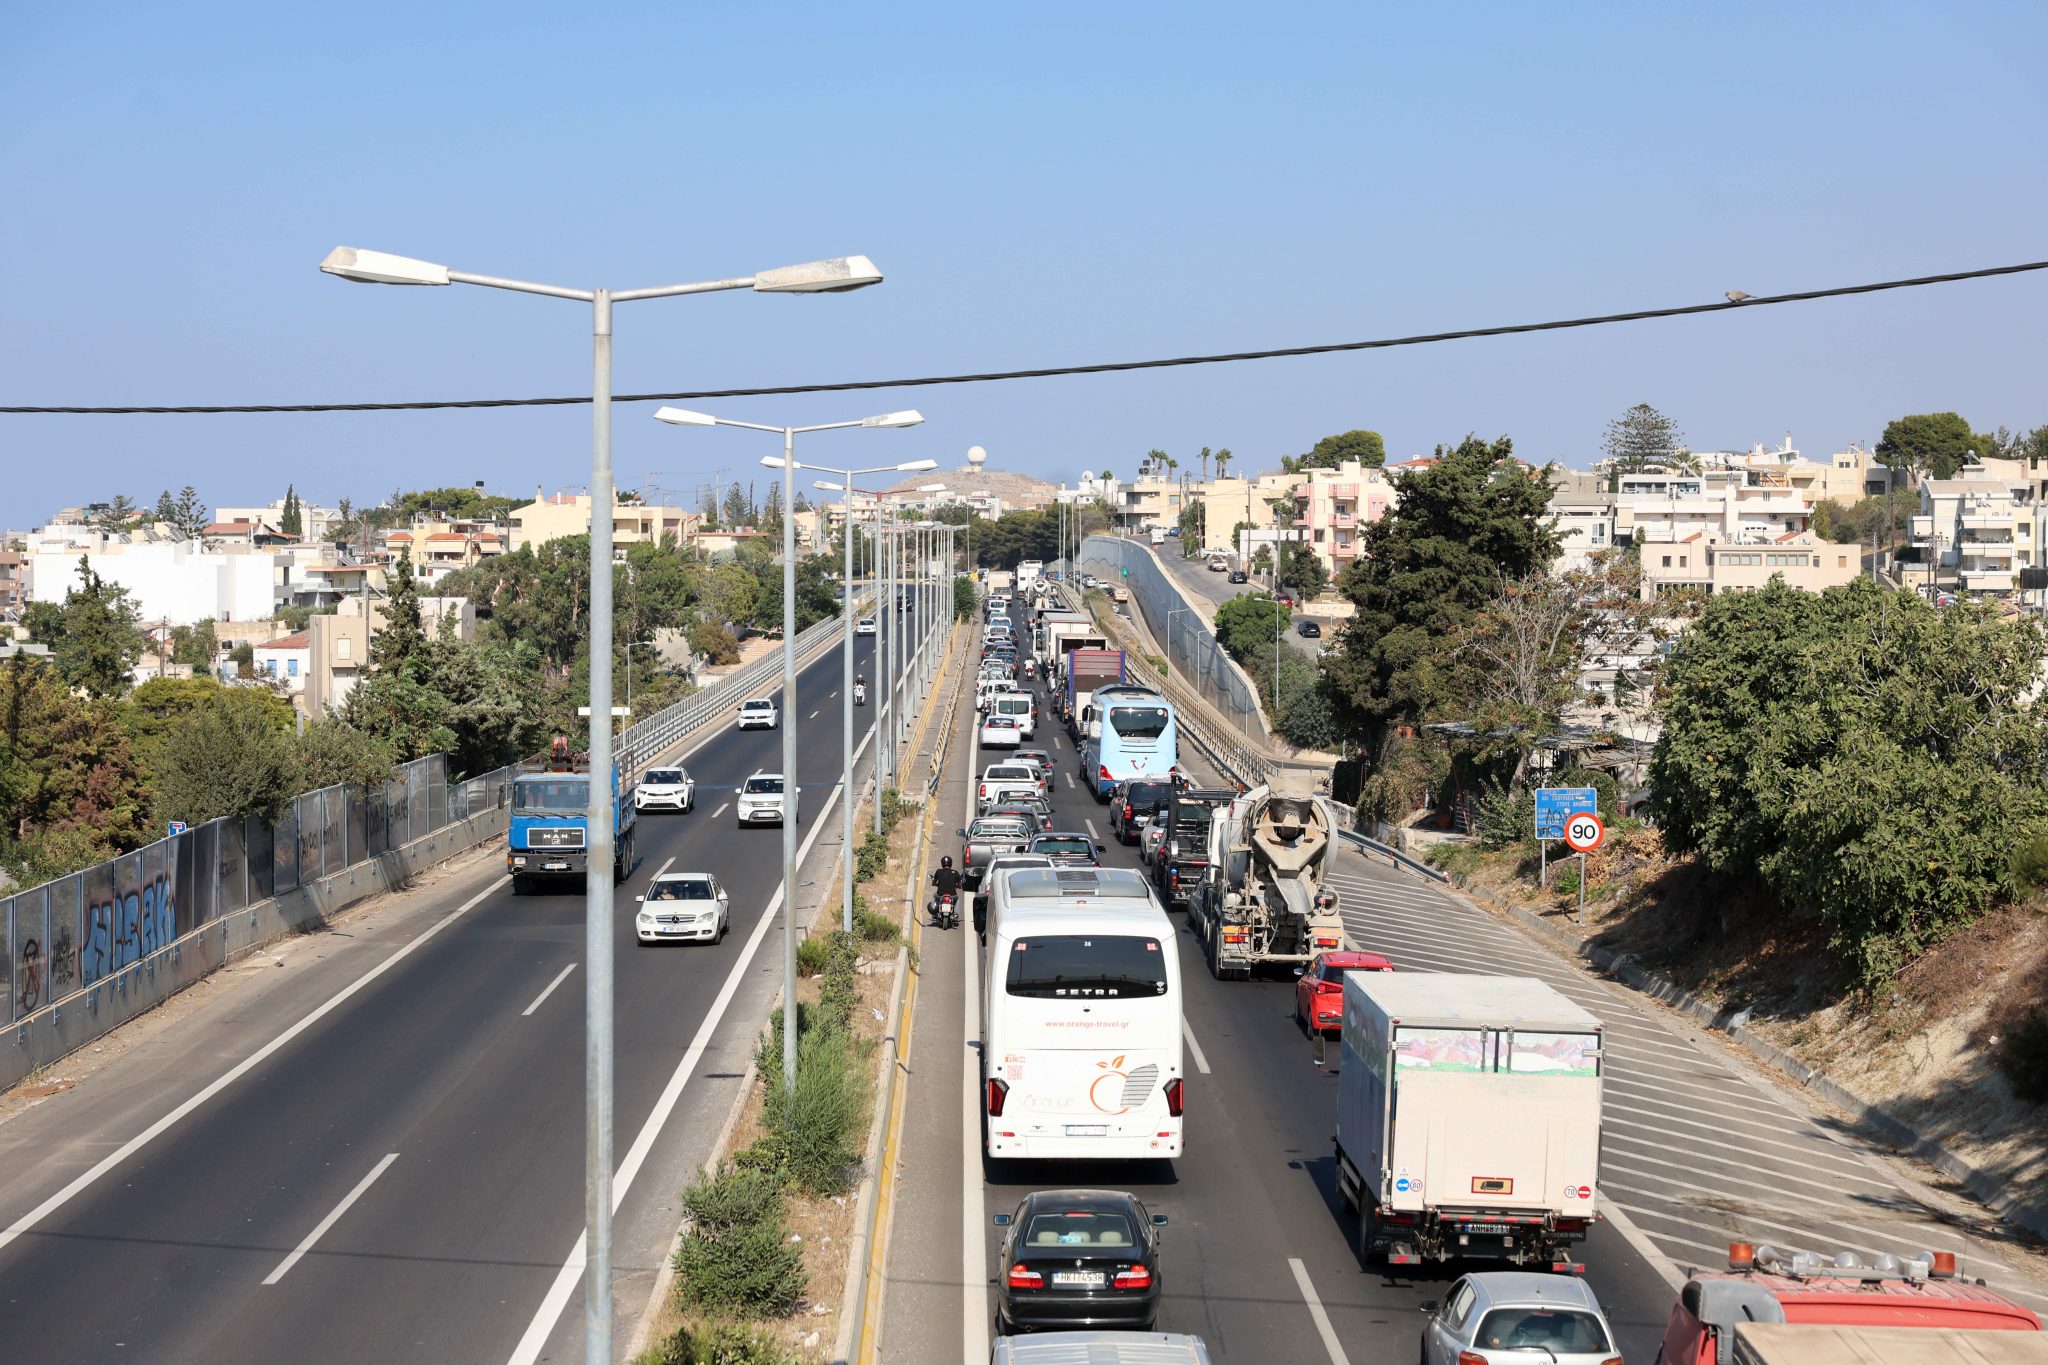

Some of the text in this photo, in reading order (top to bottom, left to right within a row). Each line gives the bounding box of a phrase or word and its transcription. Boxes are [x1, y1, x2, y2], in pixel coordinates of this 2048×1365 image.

[1572, 824, 1596, 839] 90
[1056, 988, 1118, 996] SETRA
[1045, 1020, 1130, 1029] www.orange-travel.gr
